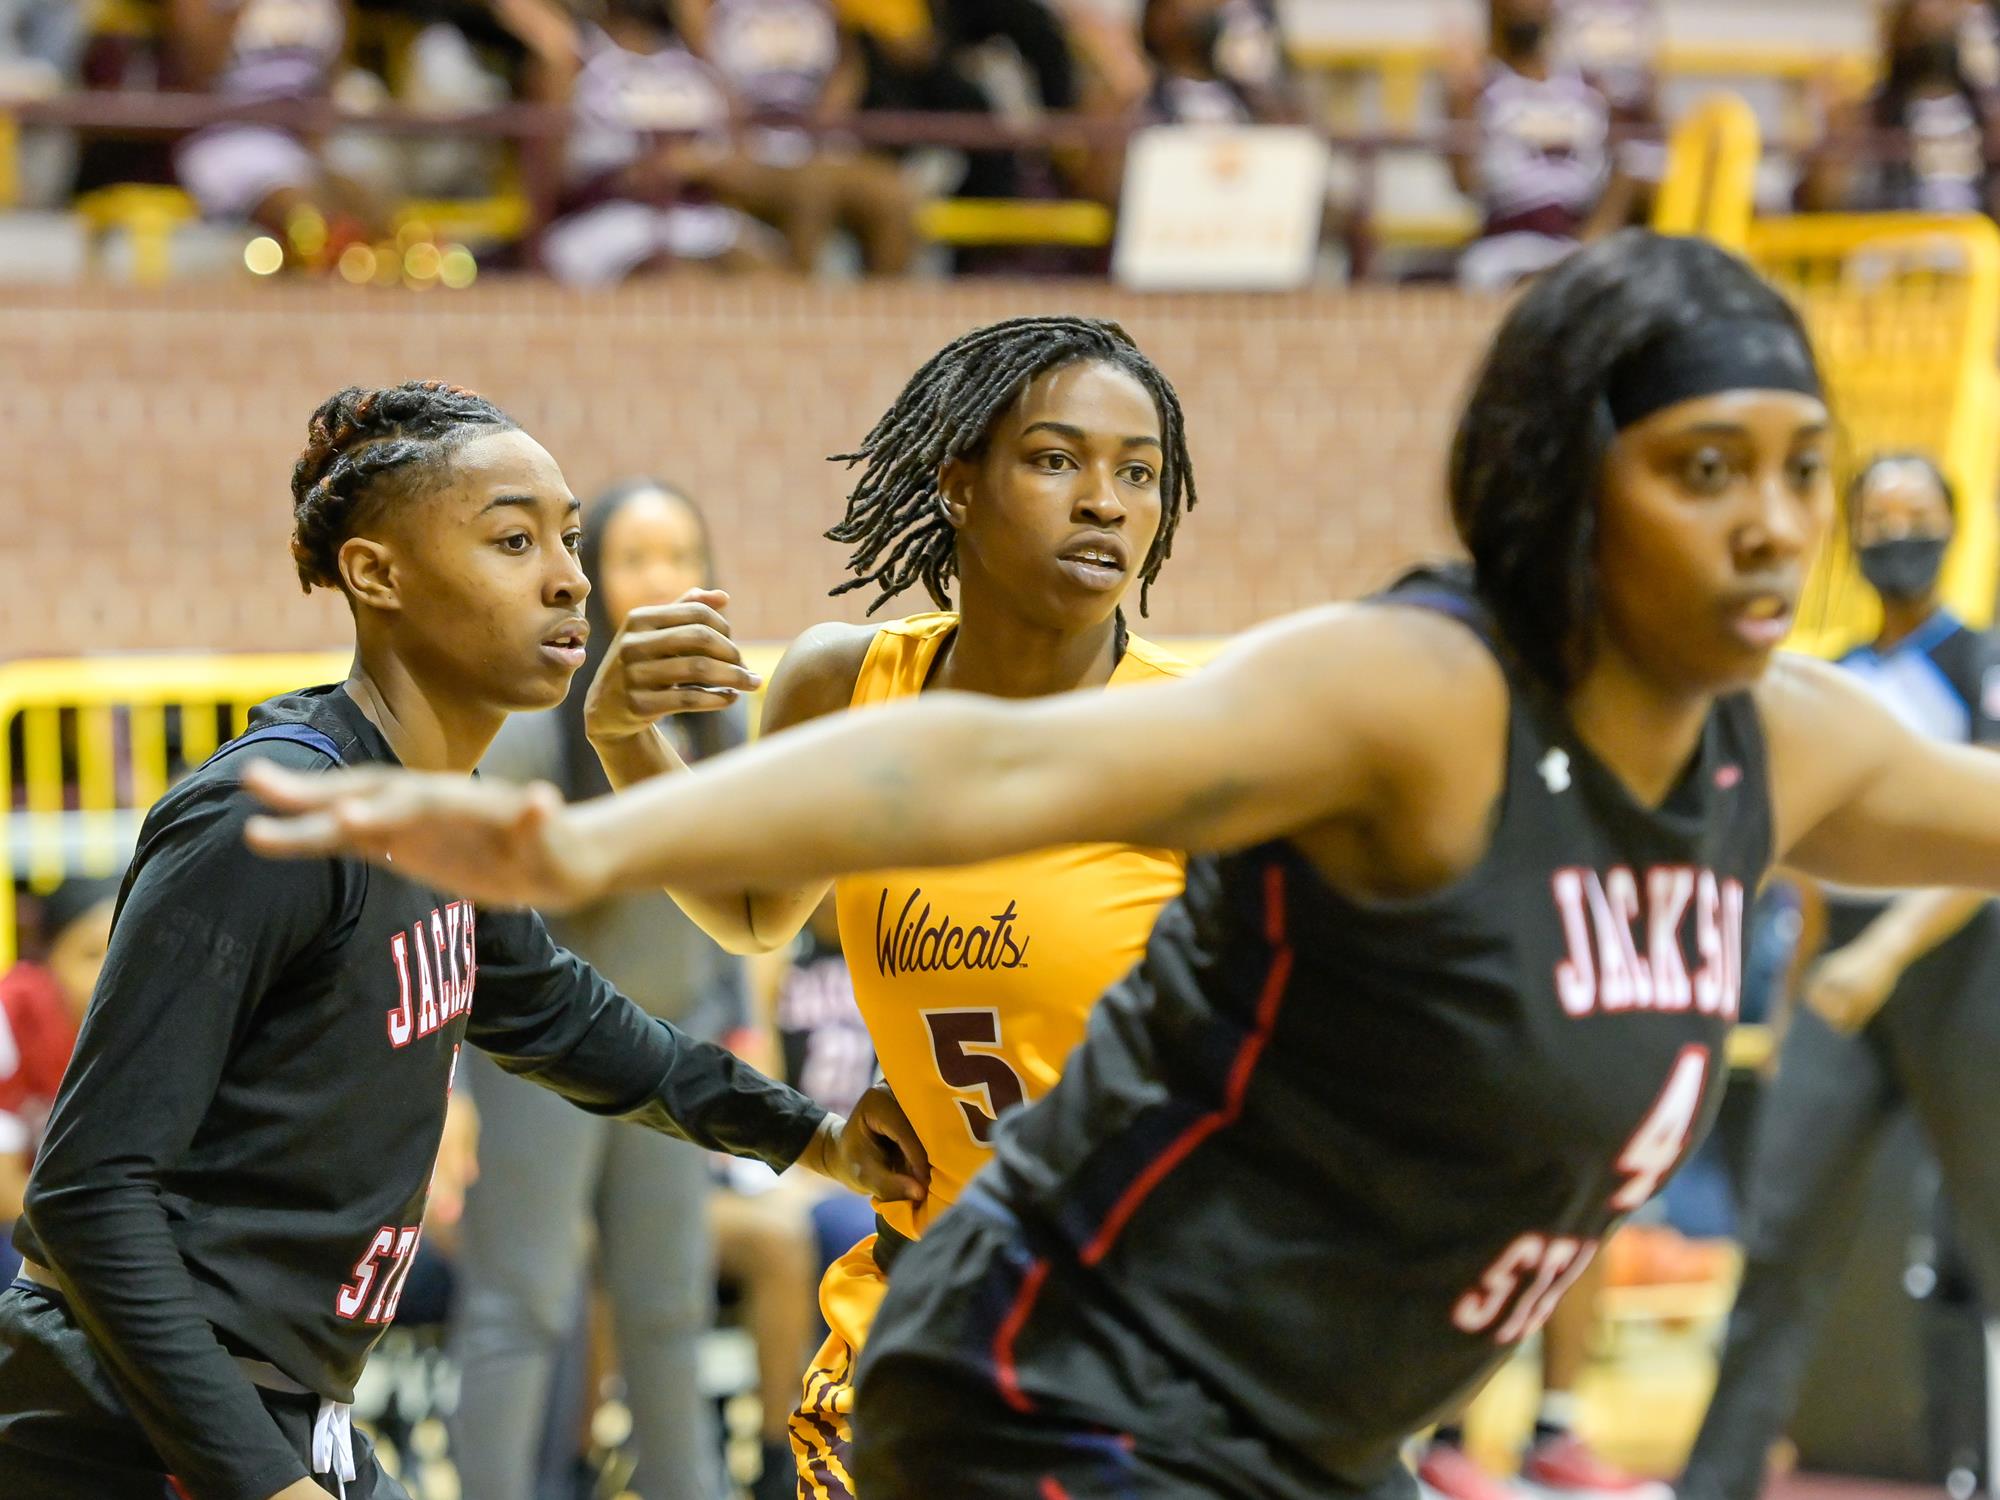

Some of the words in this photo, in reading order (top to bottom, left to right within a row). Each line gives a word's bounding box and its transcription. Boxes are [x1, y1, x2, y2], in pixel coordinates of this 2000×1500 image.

[875, 887, 1030, 977] Wildcats
[917, 1006, 1029, 1147] 5
[1608, 1042, 1712, 1211] 4
